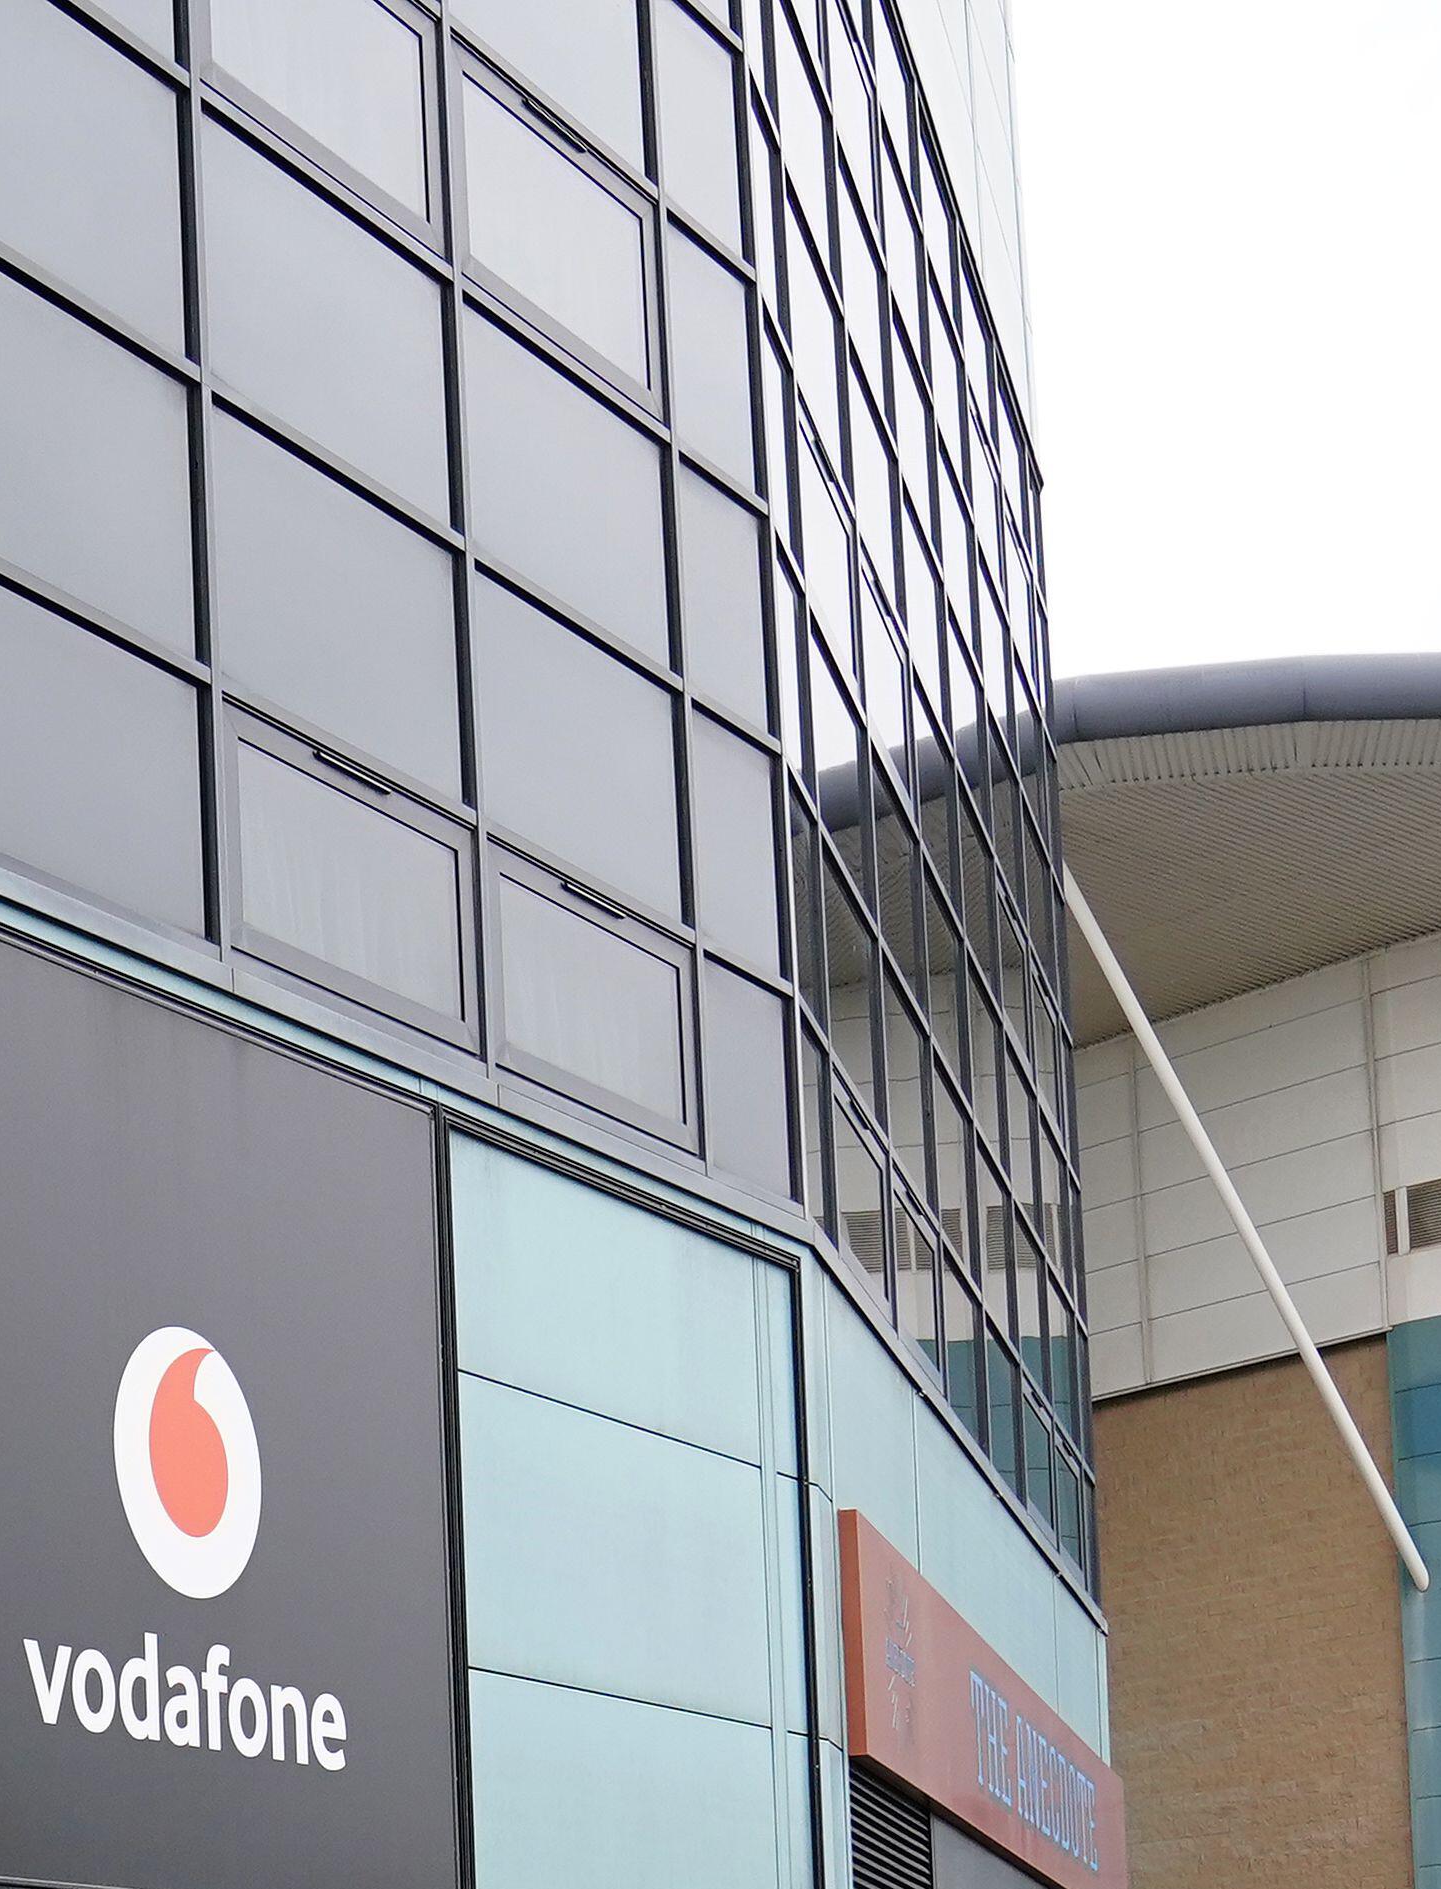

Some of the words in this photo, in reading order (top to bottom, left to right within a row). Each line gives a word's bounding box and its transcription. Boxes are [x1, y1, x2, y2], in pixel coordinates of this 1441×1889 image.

[23, 1631, 347, 1772] vodafone
[970, 1671, 1013, 1807] THE
[1016, 1714, 1099, 1872] ANECDOTE
